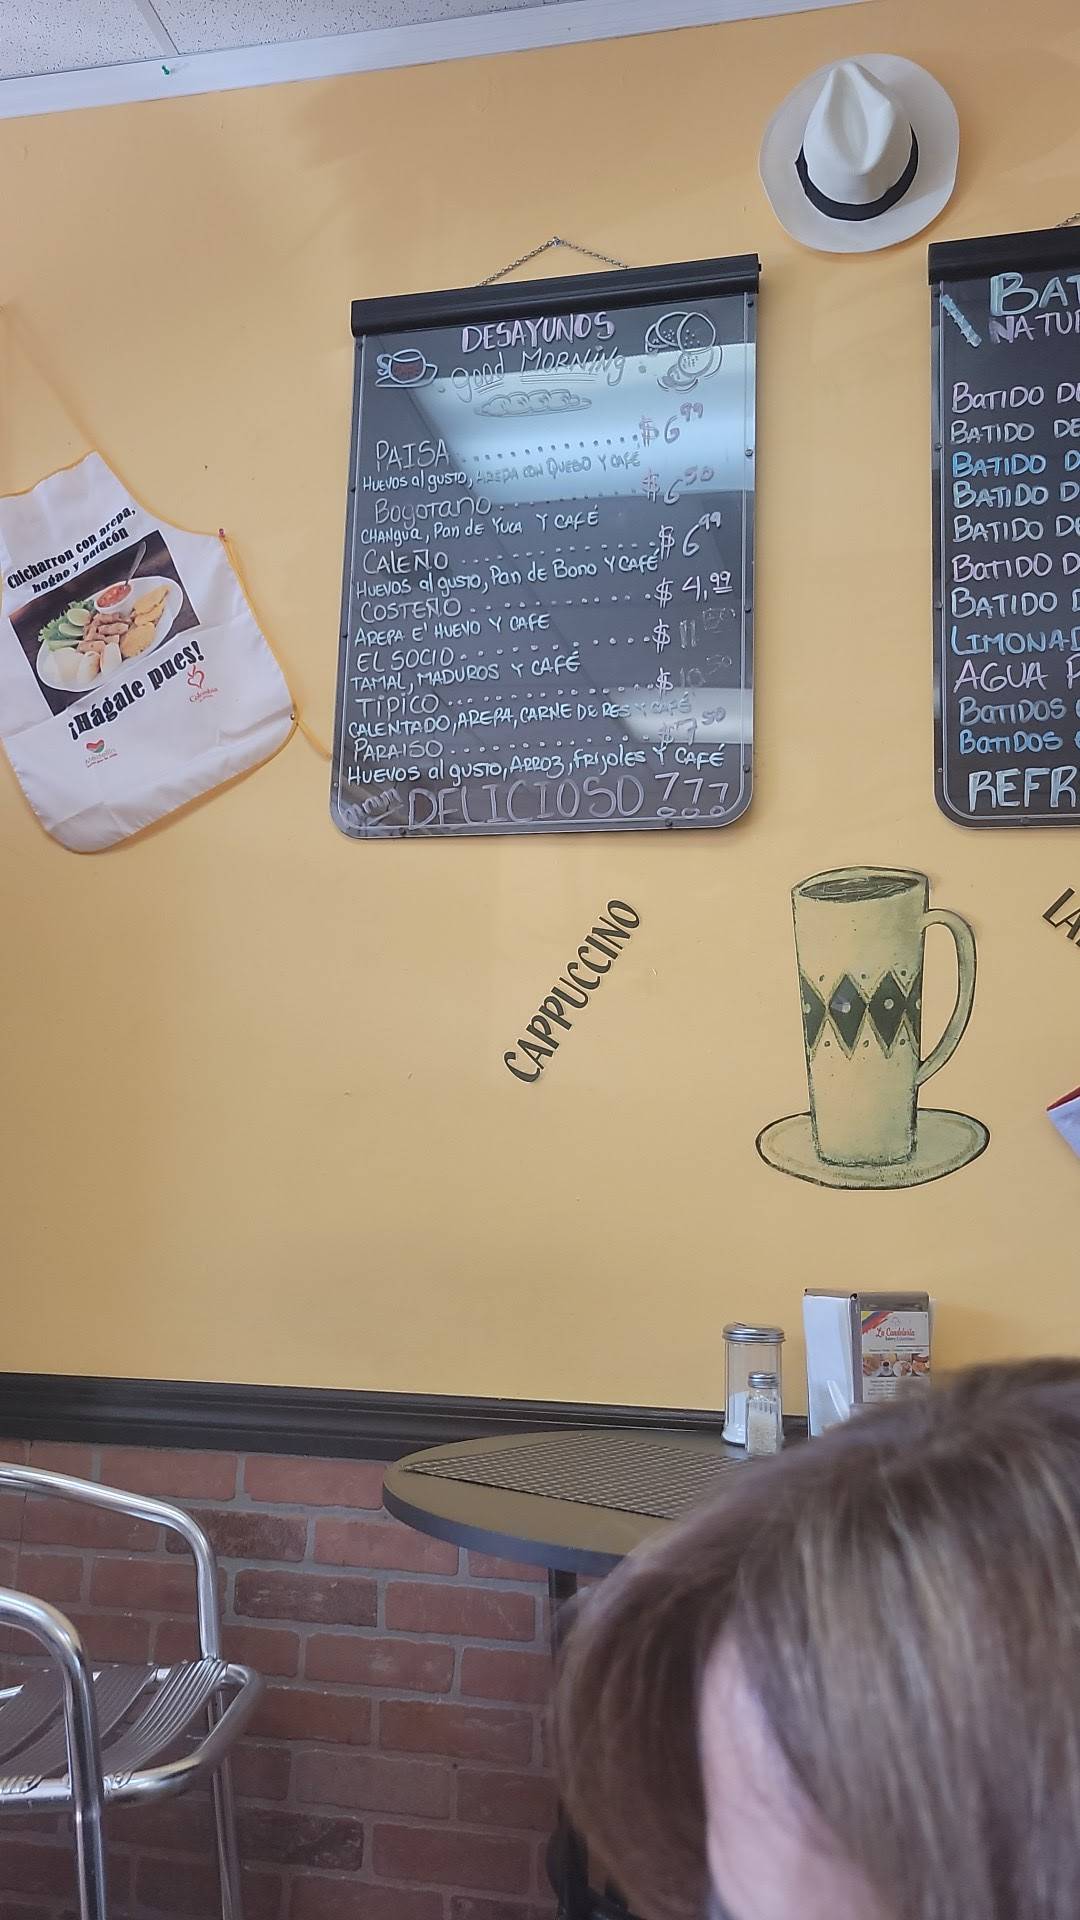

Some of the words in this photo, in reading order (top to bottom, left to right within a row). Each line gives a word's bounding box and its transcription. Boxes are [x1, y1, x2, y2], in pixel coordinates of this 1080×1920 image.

[462, 312, 616, 353] DESAYUNOS
[952, 382, 1045, 414] BaTIDO
[951, 420, 1035, 444] BATIDO
[376, 439, 450, 472] PAISA
[952, 451, 1047, 478] BATIDO
[363, 476, 408, 492] HUEVOS
[412, 470, 424, 486] al
[523, 463, 543, 478] CON
[598, 453, 607, 472] Y
[952, 481, 1049, 509] BATIDO
[433, 522, 460, 539] Pan
[492, 518, 522, 534] YUCA
[536, 513, 548, 531] Y
[554, 505, 599, 530] CAFÉ
[952, 514, 1043, 542] BATIDO
[7, 549, 75, 589] Chicharron
[75, 534, 98, 553] con
[99, 507, 136, 537] arepa,
[32, 569, 71, 594] hogao
[72, 562, 80, 573] y
[82, 527, 129, 565] patacón
[363, 549, 449, 575] CALEÑO
[357, 579, 412, 599] HUEVOS
[419, 572, 433, 593] al
[489, 565, 522, 585] Pan
[552, 558, 597, 578] Bono
[604, 555, 615, 573] Y
[618, 548, 660, 573] CAFÉ
[951, 553, 1052, 583] BaTIDO
[360, 597, 462, 623] COSTEÑO
[951, 586, 1058, 619] BATIDO
[354, 626, 404, 647] AREPA
[434, 620, 481, 640] HUEVO
[489, 615, 501, 632] Y
[509, 613, 551, 631] CAFE
[350, 677, 414, 695] TAMAL,
[417, 663, 500, 687] MADUROS
[511, 663, 524, 678] Y
[532, 651, 581, 676] CAFÉ
[356, 651, 385, 673] EL
[390, 647, 454, 672] SOCIO
[953, 658, 1048, 693] AGUA
[68, 680, 145, 740] ¡Hágale
[147, 641, 204, 691] pues!
[520, 703, 572, 725] CARNE
[577, 704, 598, 721] DE
[602, 702, 631, 719] RES
[635, 703, 648, 718] Y
[958, 696, 1067, 727] BaTIDOS
[354, 738, 443, 763] PARAISO
[959, 729, 1064, 755] BaTIDOS
[348, 766, 420, 786] HUEVOS
[428, 759, 444, 779] al
[652, 745, 667, 765] Y
[675, 744, 726, 770] CAFÉ
[408, 775, 645, 831] DELICIOSO
[503, 899, 640, 1083] CAPPUCCINO
